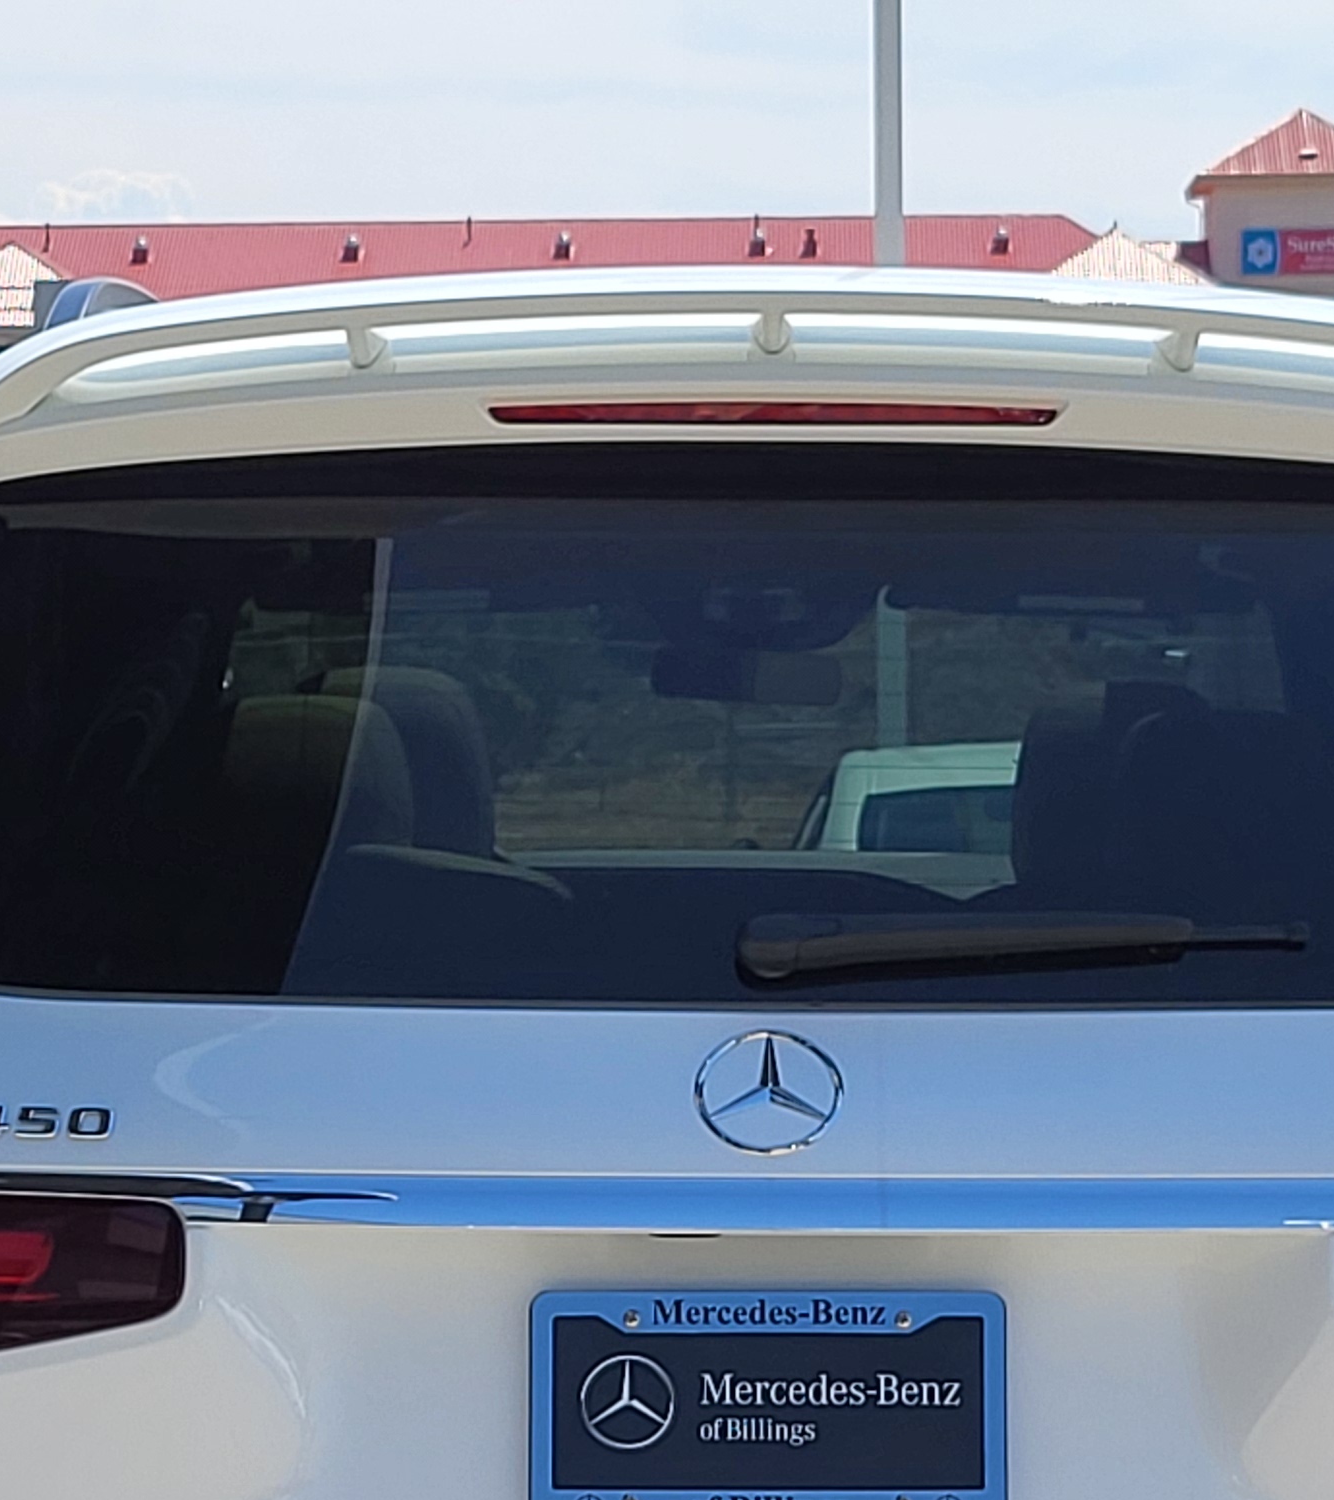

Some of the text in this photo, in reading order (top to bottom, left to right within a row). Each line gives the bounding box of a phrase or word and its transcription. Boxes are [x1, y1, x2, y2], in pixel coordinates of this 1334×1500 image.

[651, 1298, 887, 1327] Mercedes-Benz
[699, 1372, 963, 1407] Mercedes-Benz
[699, 1417, 817, 1447] of Billings
